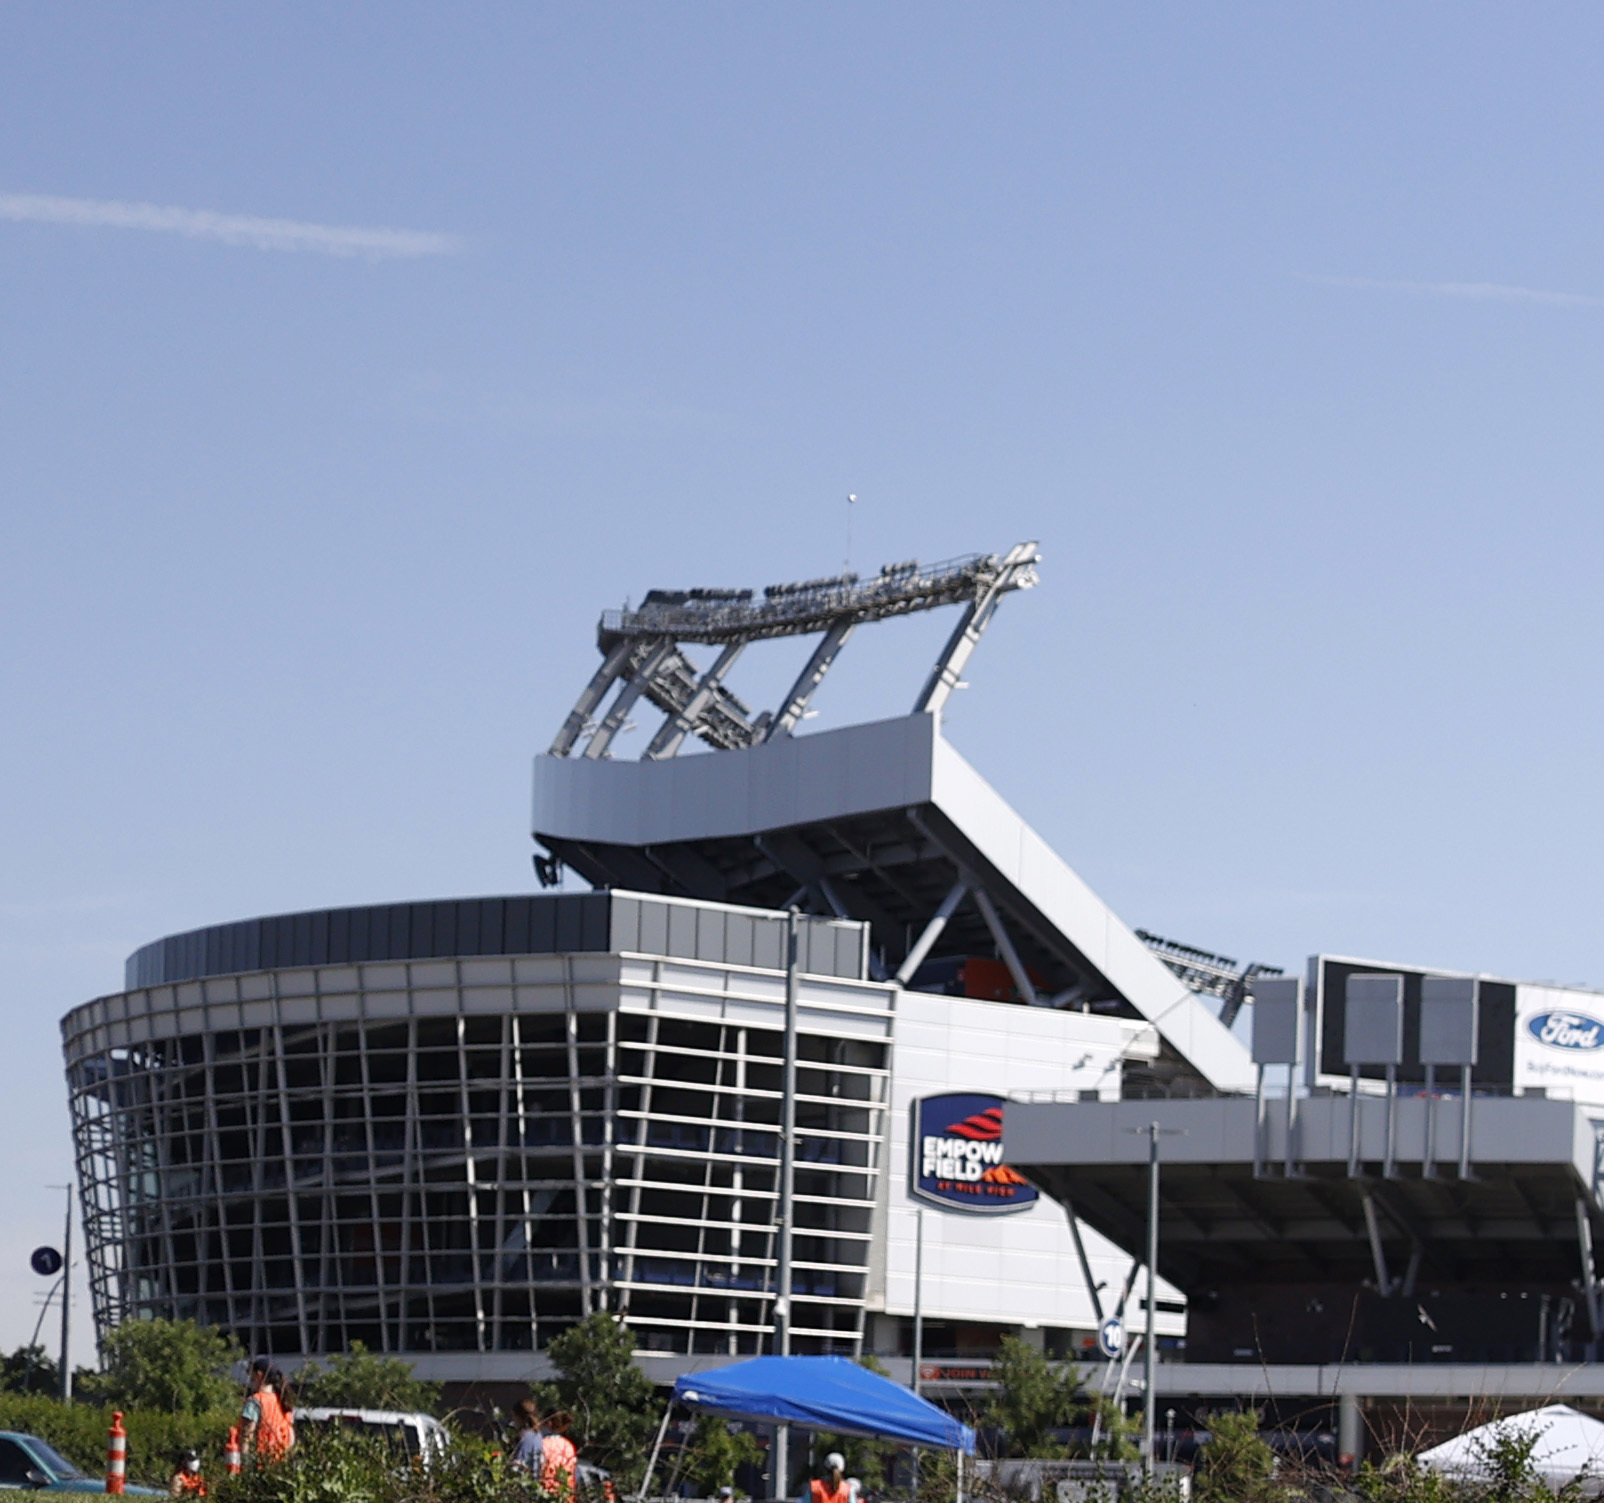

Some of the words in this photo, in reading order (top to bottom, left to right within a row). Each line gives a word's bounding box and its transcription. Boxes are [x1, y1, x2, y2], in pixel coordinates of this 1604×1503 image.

[1540, 1012, 1600, 1048] Ford
[922, 1156, 983, 1182] FIELD
[1104, 1326, 1122, 1348] 10
